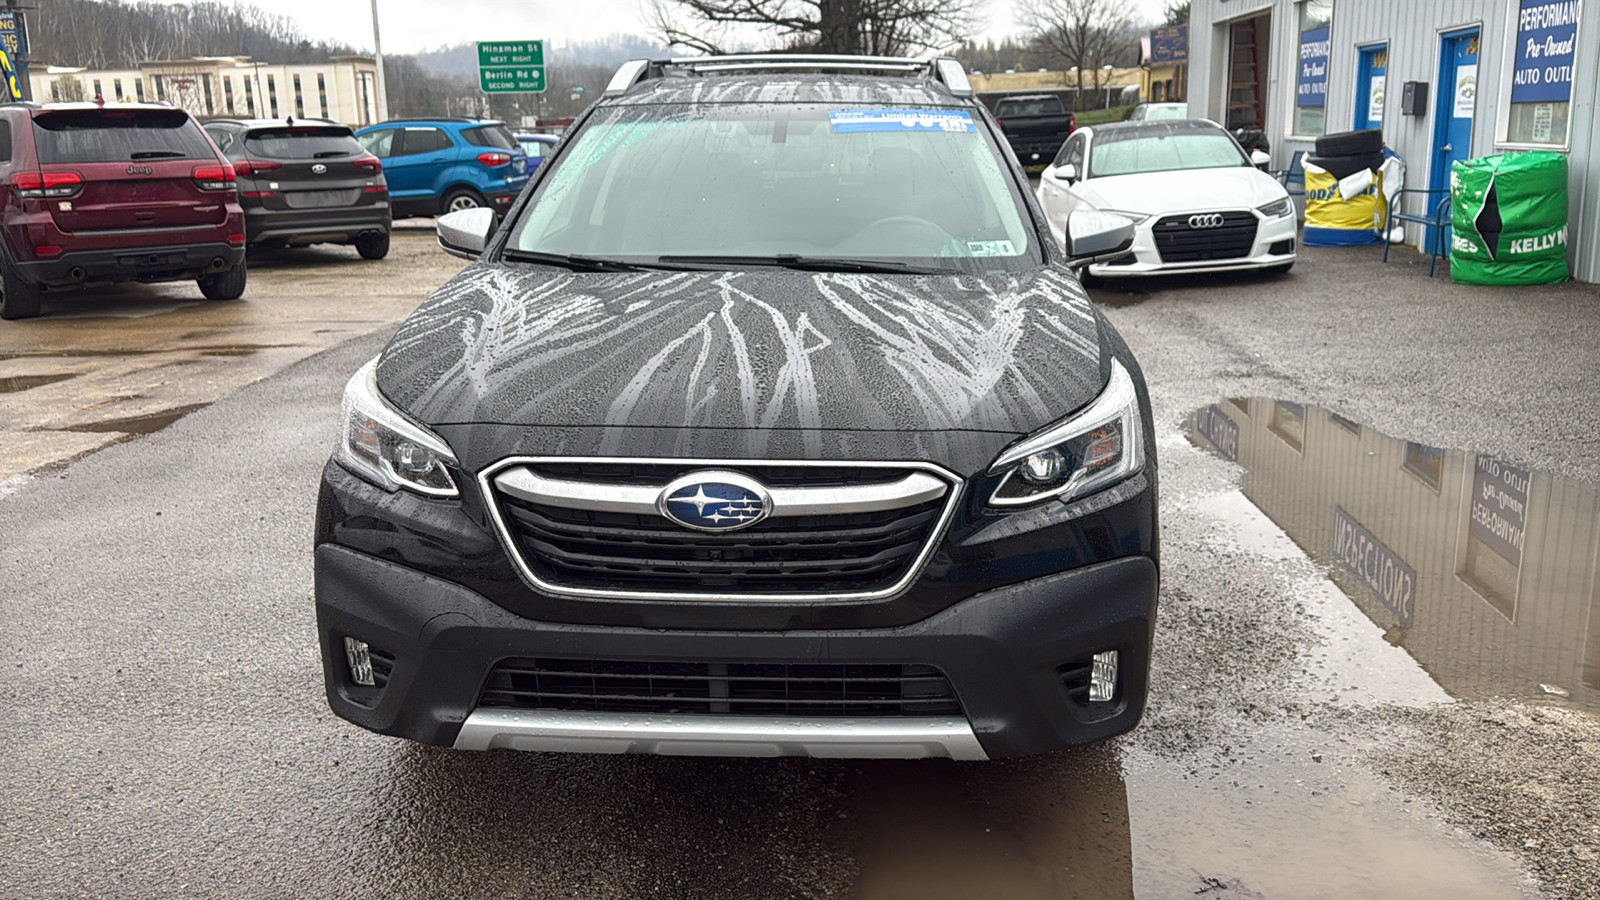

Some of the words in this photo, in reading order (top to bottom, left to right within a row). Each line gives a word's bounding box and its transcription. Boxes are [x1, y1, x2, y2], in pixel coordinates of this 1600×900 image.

[528, 44, 538, 52] St
[1525, 32, 1575, 59] Pre-Owned
[485, 71, 513, 79] Berlin
[517, 70, 528, 79] Rd
[1514, 68, 1540, 85] AUTO
[127, 166, 152, 175] Jeep
